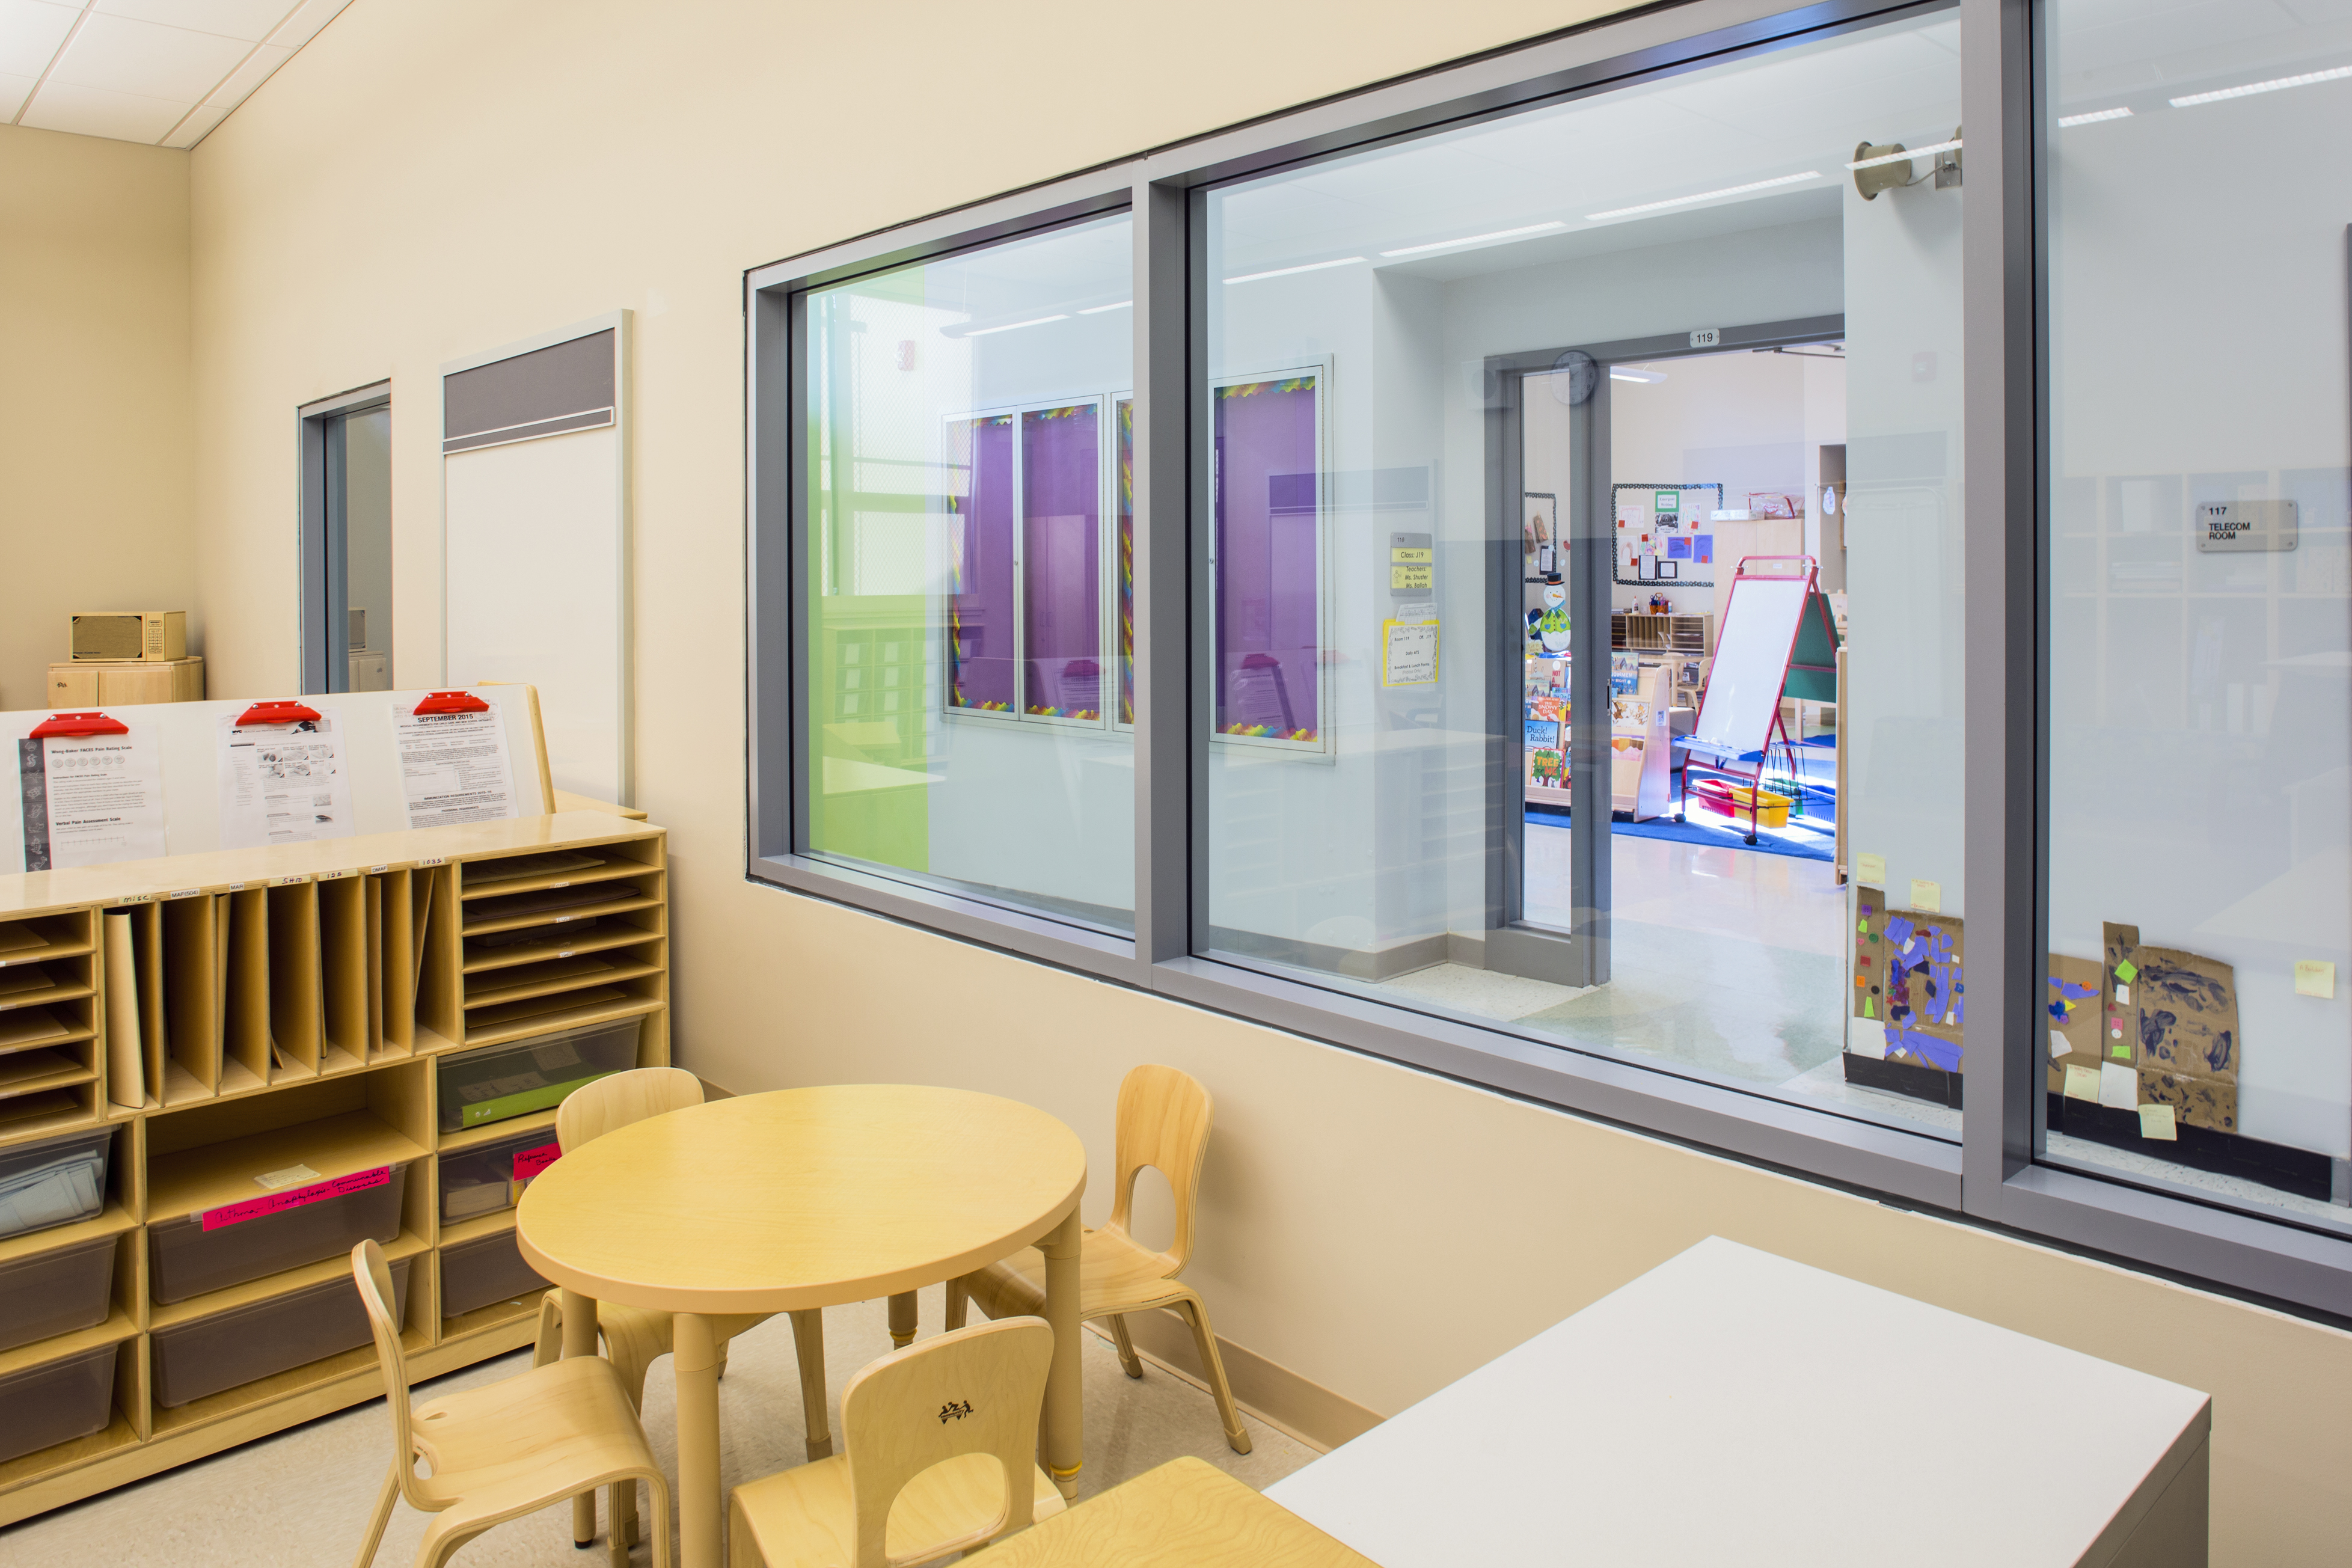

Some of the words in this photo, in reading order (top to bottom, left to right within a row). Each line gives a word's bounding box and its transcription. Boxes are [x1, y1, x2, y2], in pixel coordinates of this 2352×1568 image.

[1697, 333, 1713, 343] 119
[2208, 507, 2227, 515] 117
[2208, 522, 2250, 531] TELECOM
[2208, 531, 2236, 540] ROOM
[1527, 726, 1548, 734] Duck!
[1530, 734, 1555, 743] Rabbit!
[1536, 756, 1559, 767] TREE
[1545, 767, 1557, 776] ME
[171, 890, 199, 898] MAF(504)
[518, 1153, 547, 1163] Reference
[536, 1157, 557, 1166] Books
